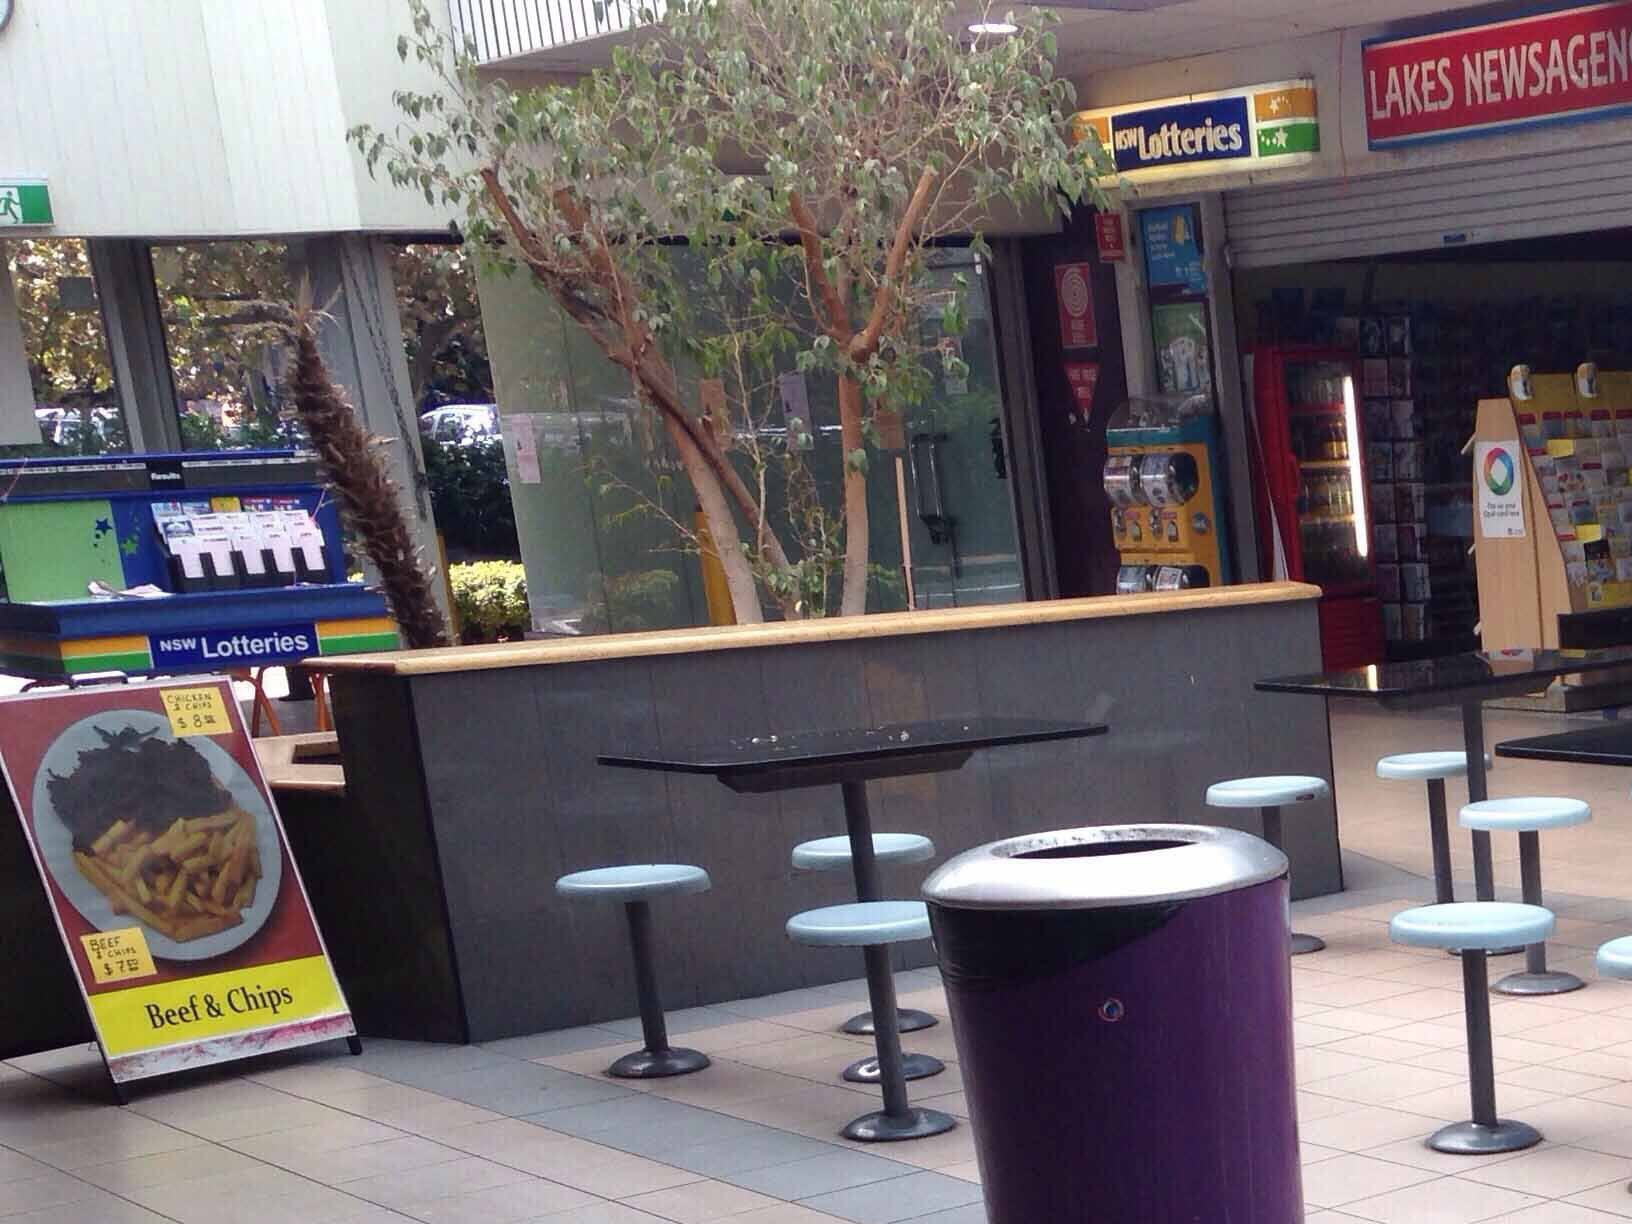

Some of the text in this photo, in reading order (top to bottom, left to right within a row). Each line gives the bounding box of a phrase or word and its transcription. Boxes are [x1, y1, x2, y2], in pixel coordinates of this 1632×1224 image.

[1370, 58, 1454, 120] LAKES
[1115, 117, 1242, 160] NSW Lotteries
[159, 632, 309, 659] NSW Lotteries
[89, 936, 120, 951] BEEF
[144, 985, 293, 1029] Beef & Chips
